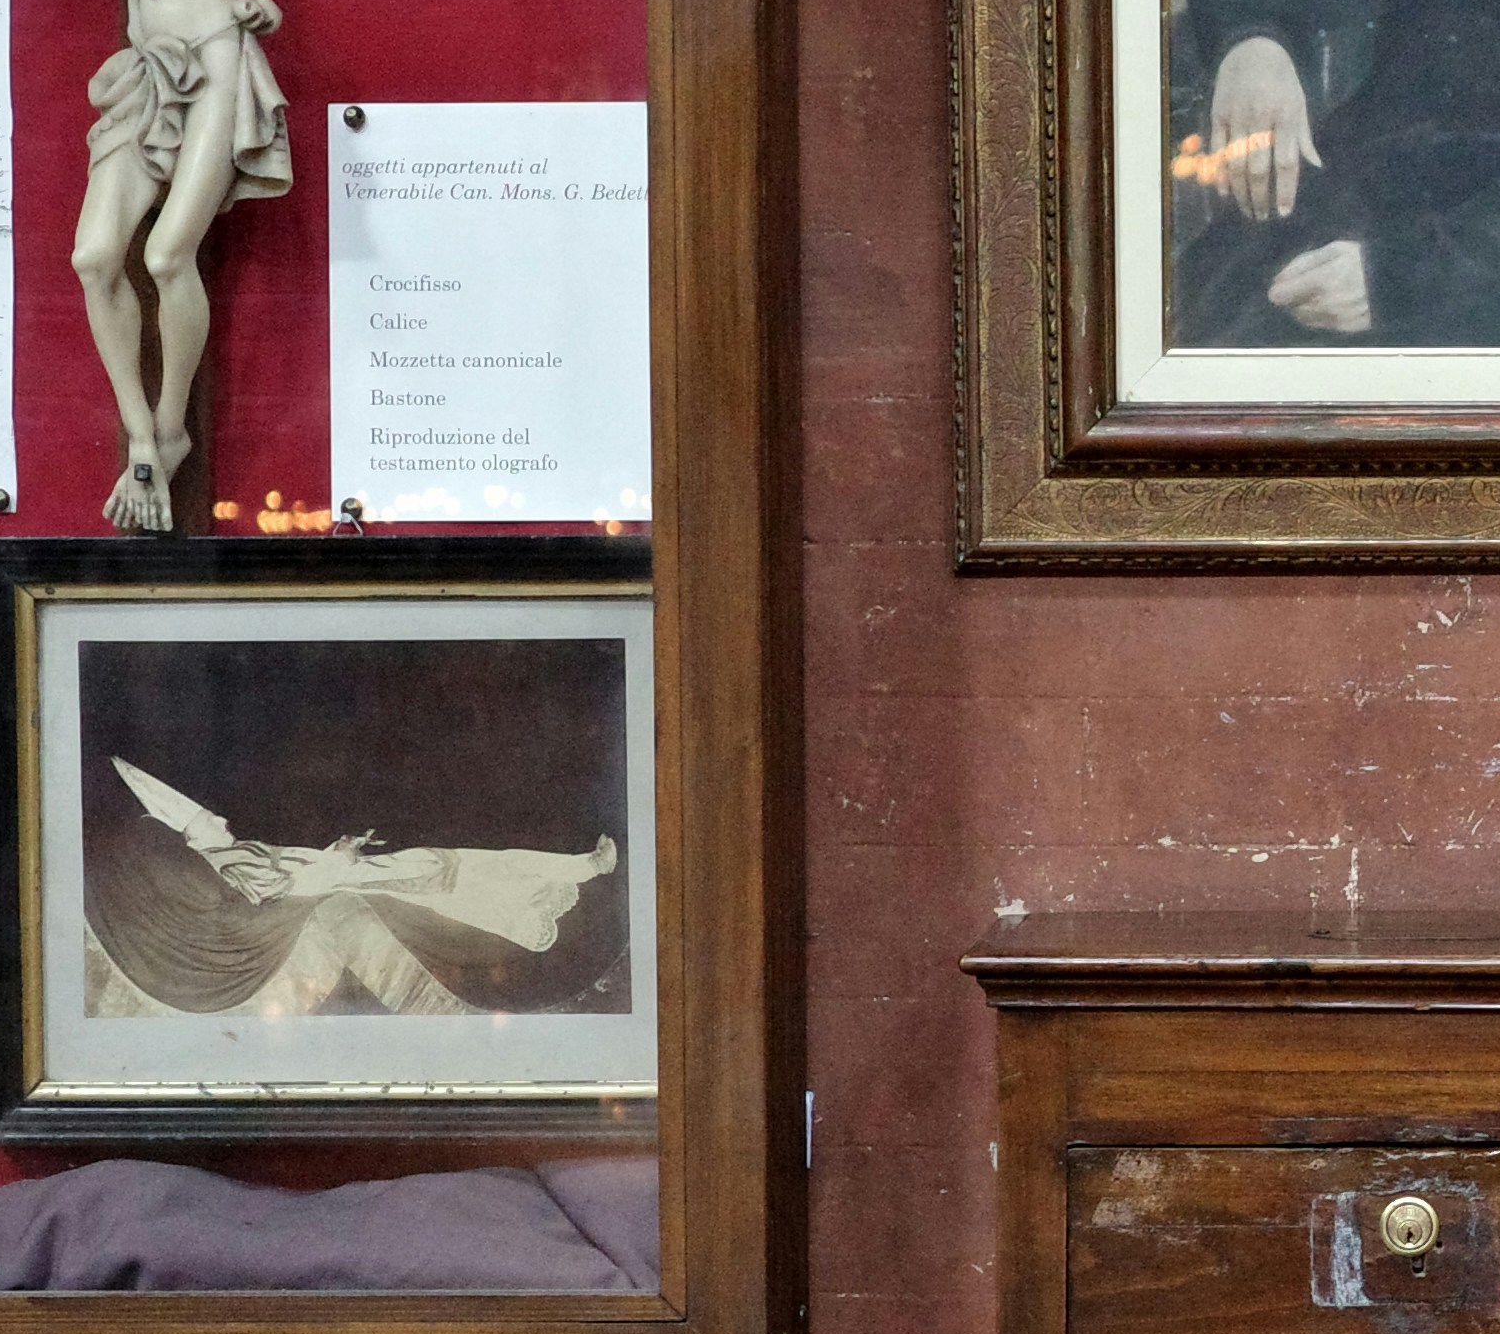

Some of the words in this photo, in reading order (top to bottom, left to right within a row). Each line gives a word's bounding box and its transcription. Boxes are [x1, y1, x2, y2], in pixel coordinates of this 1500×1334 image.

[341, 157, 405, 177] oggetti
[410, 157, 524, 179] appartenuti
[528, 157, 549, 175] al
[344, 181, 444, 202] Venerabile
[449, 182, 493, 200] Can.
[499, 182, 556, 201] Mons.
[563, 182, 583, 201] G.
[368, 273, 462, 292] Crocifisso
[368, 311, 428, 330] Calice
[369, 350, 456, 368] Mozzetta
[461, 350, 563, 368] canonicale
[370, 388, 447, 406] Bastone
[370, 426, 496, 449] Riproduzione
[501, 426, 531, 445] del
[369, 455, 477, 471] testamento
[480, 452, 559, 475] olografo
